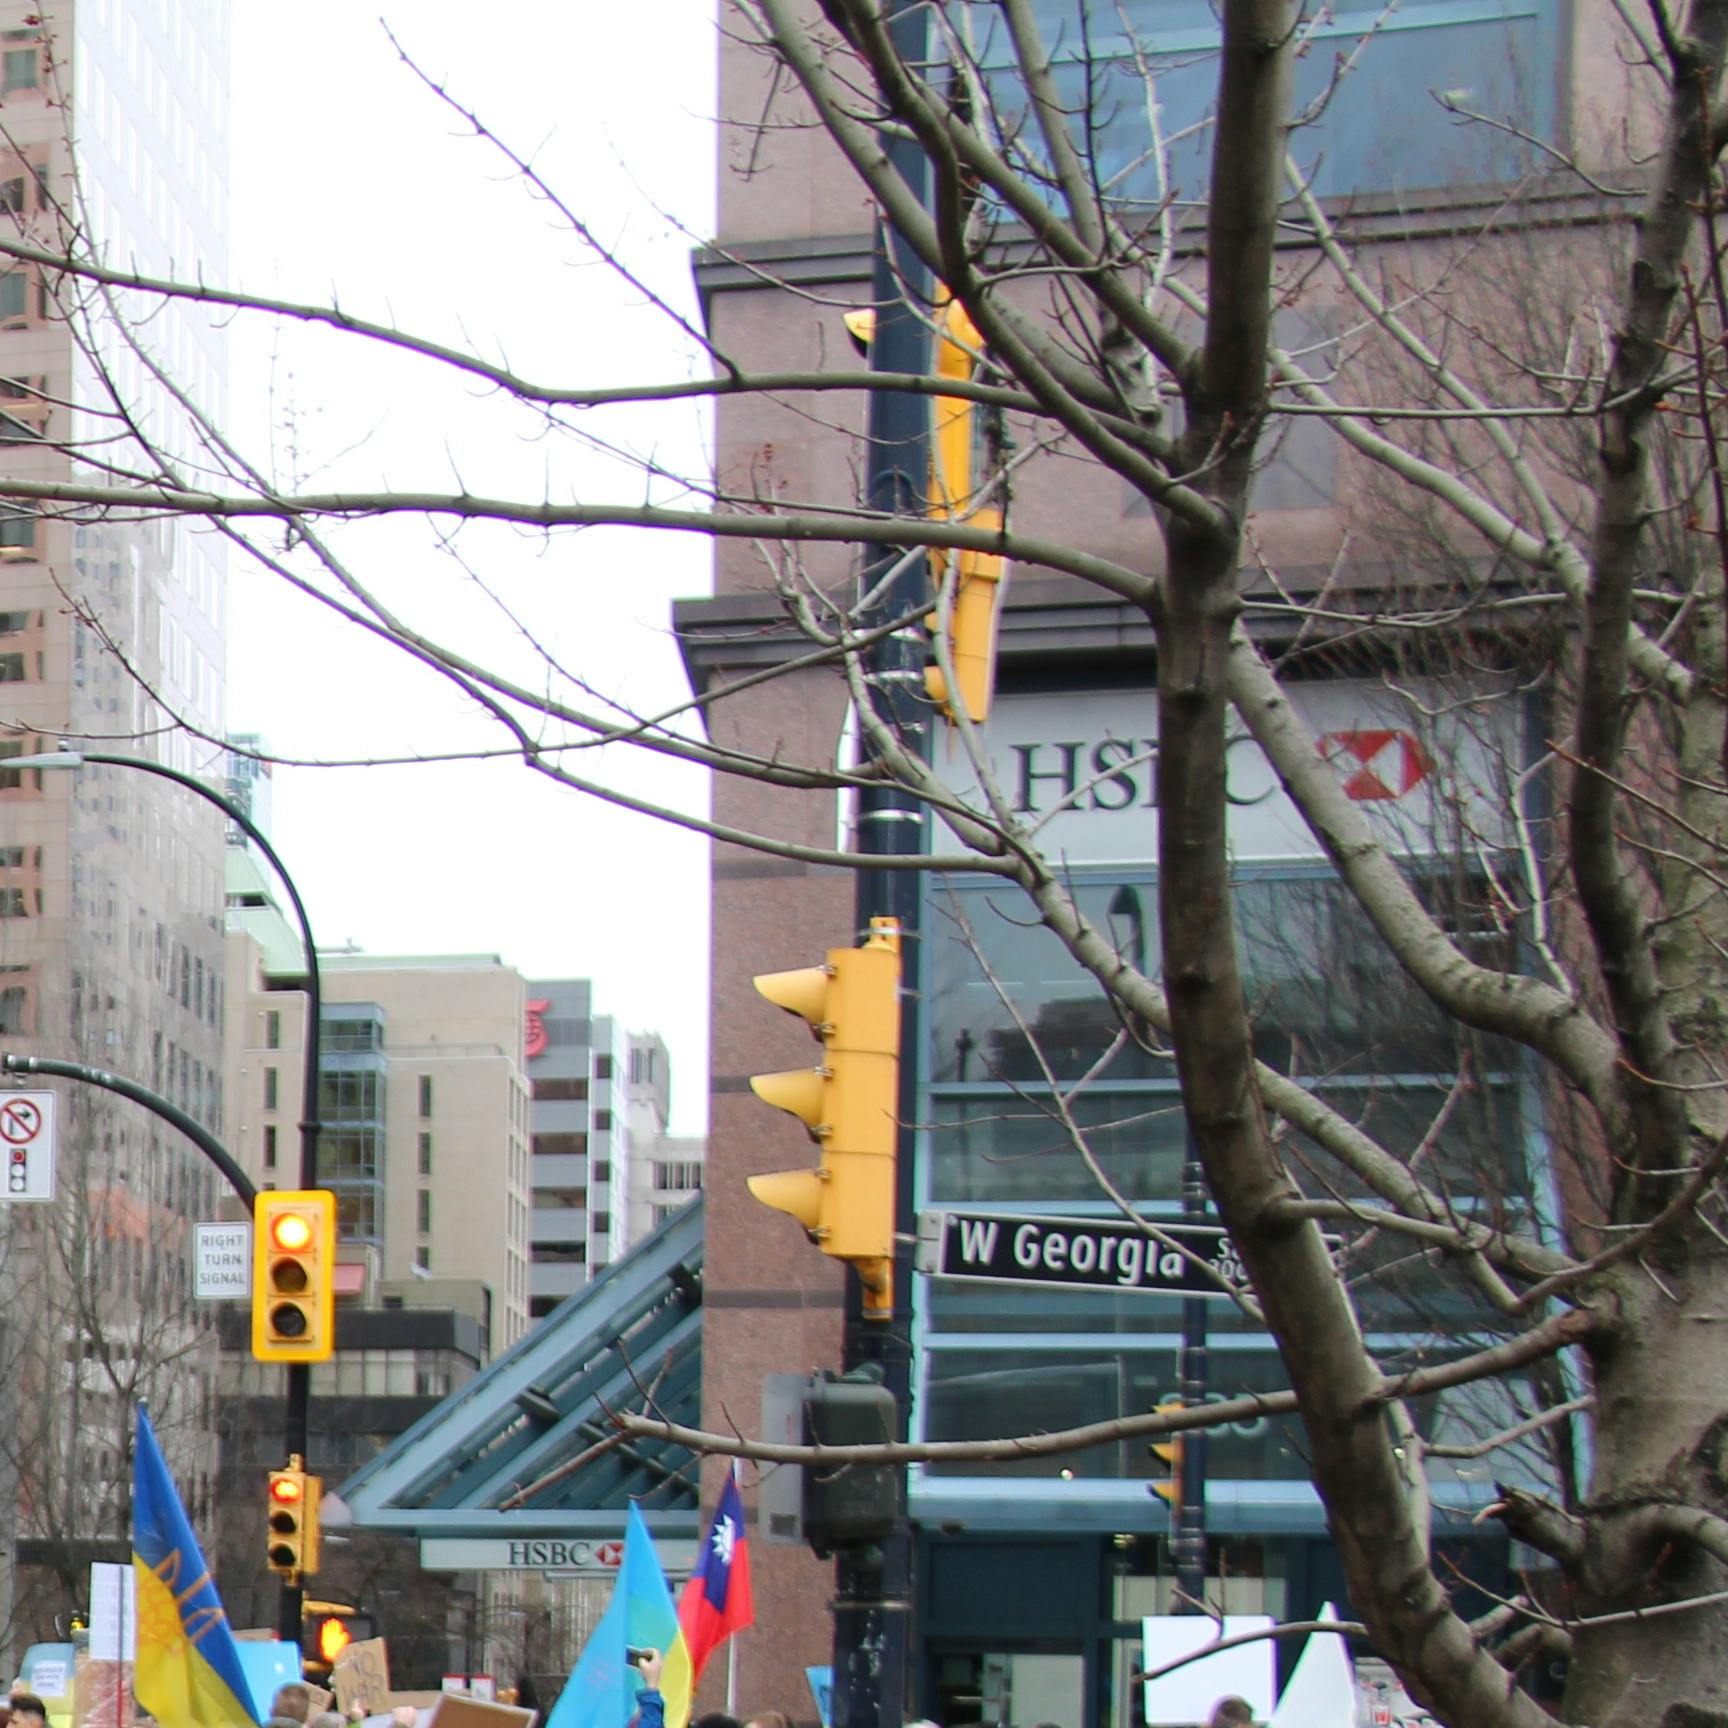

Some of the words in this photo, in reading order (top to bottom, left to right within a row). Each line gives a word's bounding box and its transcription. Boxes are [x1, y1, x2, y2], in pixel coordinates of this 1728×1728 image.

[1009, 734, 1279, 812] HSC
[200, 1234, 244, 1247] RIGHT
[204, 1253, 241, 1265] TURN
[959, 1218, 998, 1264] W
[1013, 1224, 1184, 1285] Georgia
[199, 1272, 245, 1285] SIGNAL
[507, 1541, 590, 1566] HSBC
